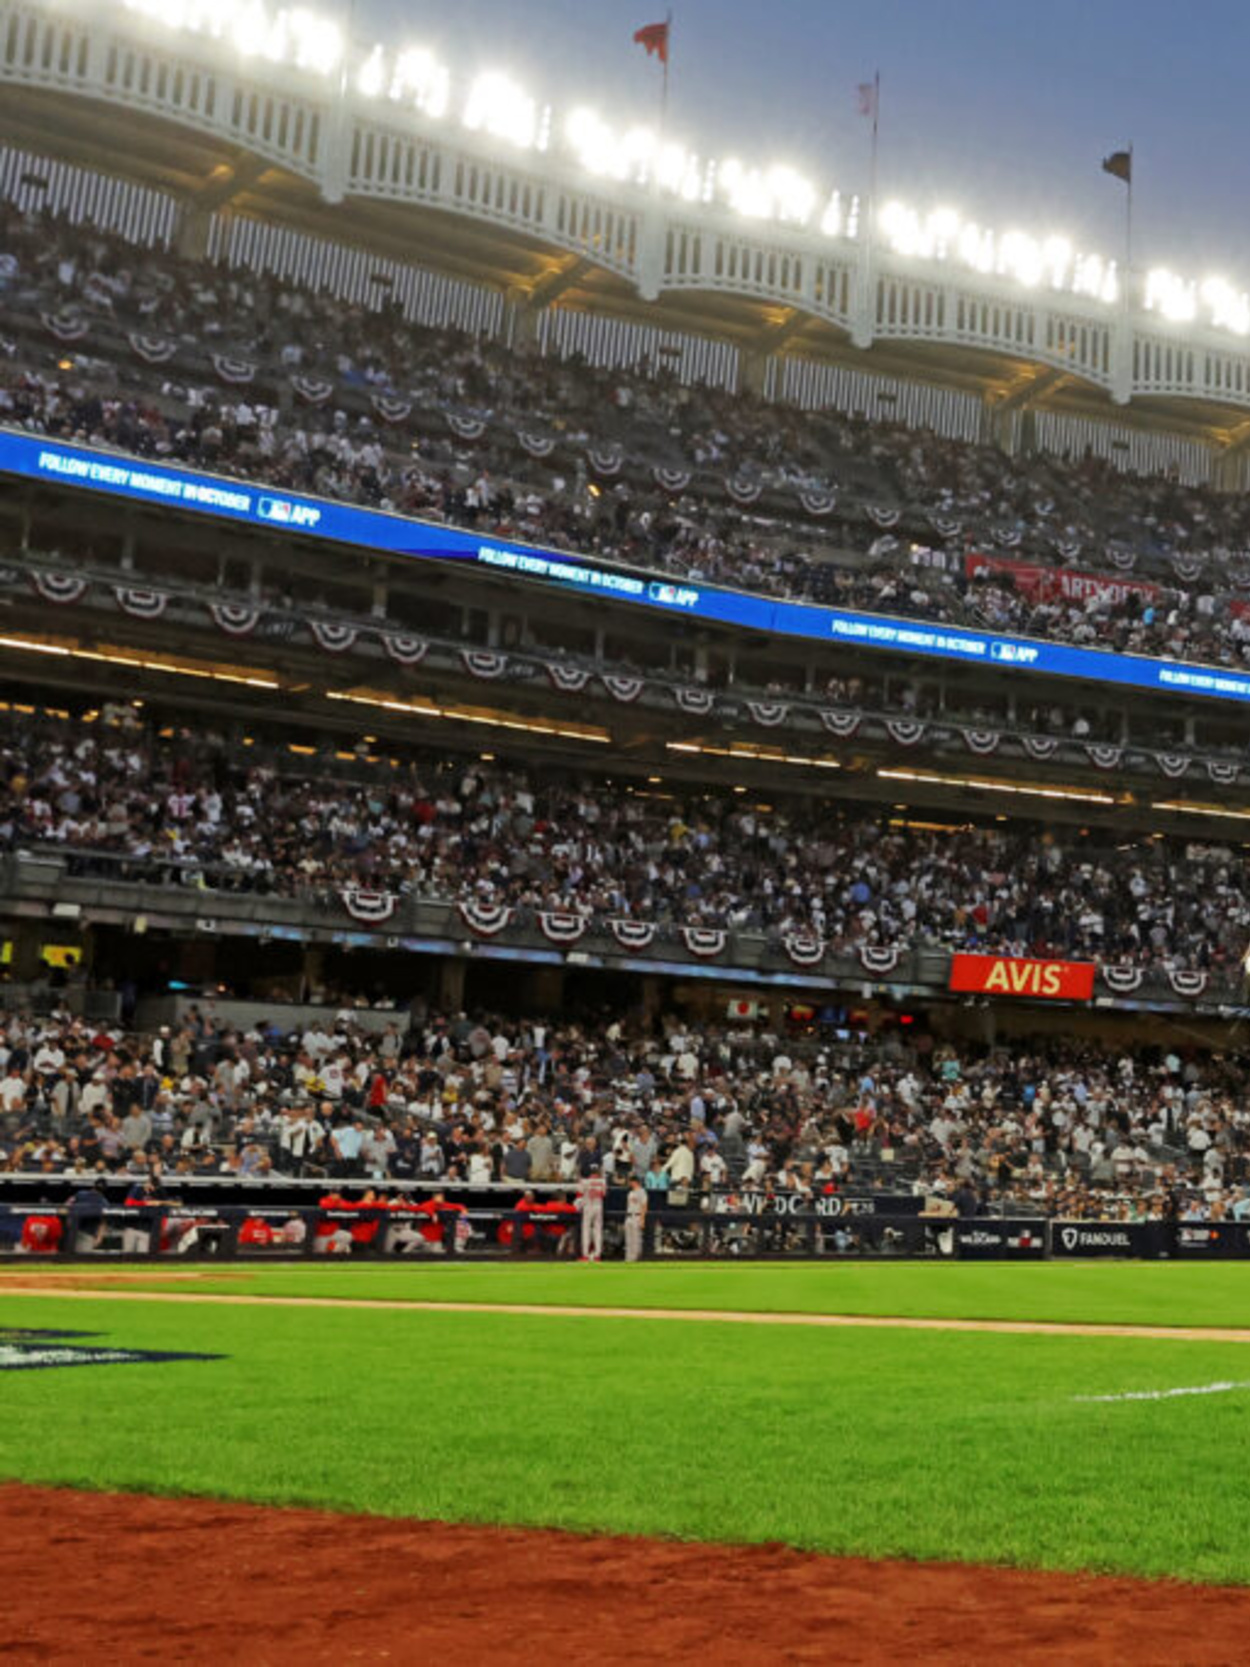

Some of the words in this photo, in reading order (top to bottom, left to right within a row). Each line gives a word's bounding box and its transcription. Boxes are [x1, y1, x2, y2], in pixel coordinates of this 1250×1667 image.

[39, 452, 90, 477] FOLLOW
[90, 463, 130, 485] EVERY
[129, 472, 182, 496] MOMENT
[183, 482, 197, 501] IN
[197, 485, 250, 511] OCTOBER
[290, 504, 320, 526] APP
[984, 961, 1062, 994] AVIS
[1080, 1231, 1131, 1246] FANDUEL
